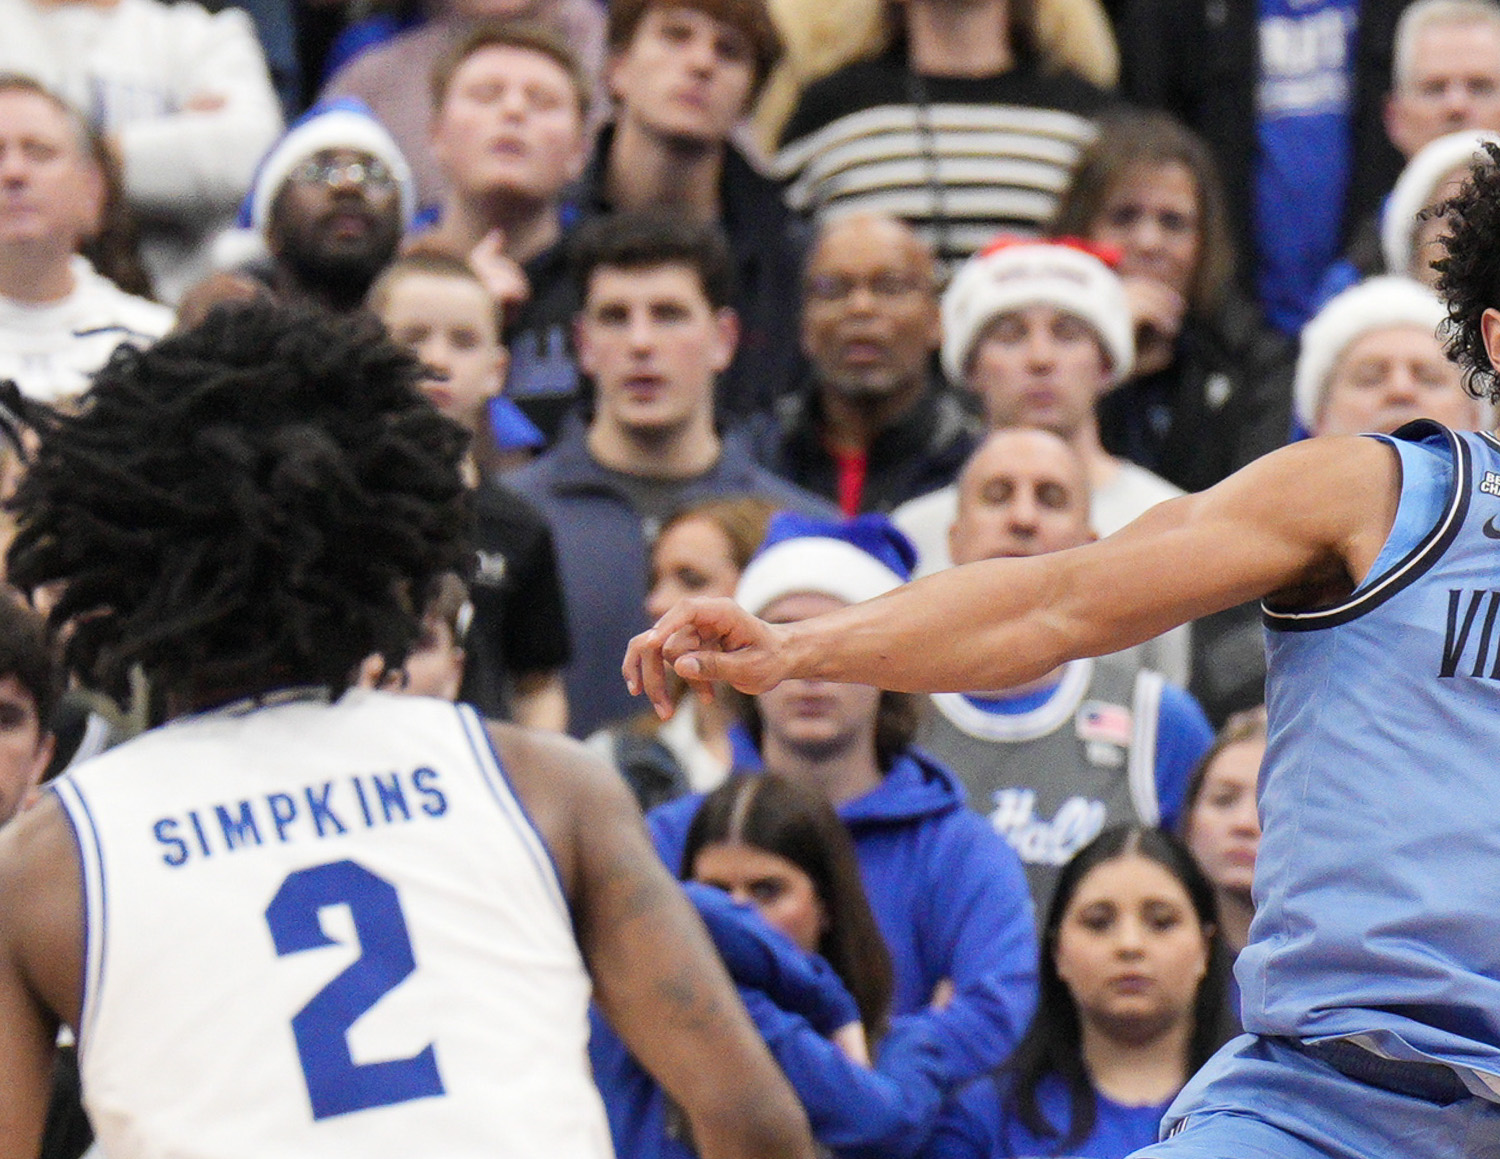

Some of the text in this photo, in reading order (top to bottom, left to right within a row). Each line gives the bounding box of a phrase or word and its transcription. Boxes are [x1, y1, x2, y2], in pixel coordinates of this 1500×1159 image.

[153, 765, 448, 868] SIMPKINS
[990, 788, 1107, 865] Hall
[264, 858, 447, 1122] 2
